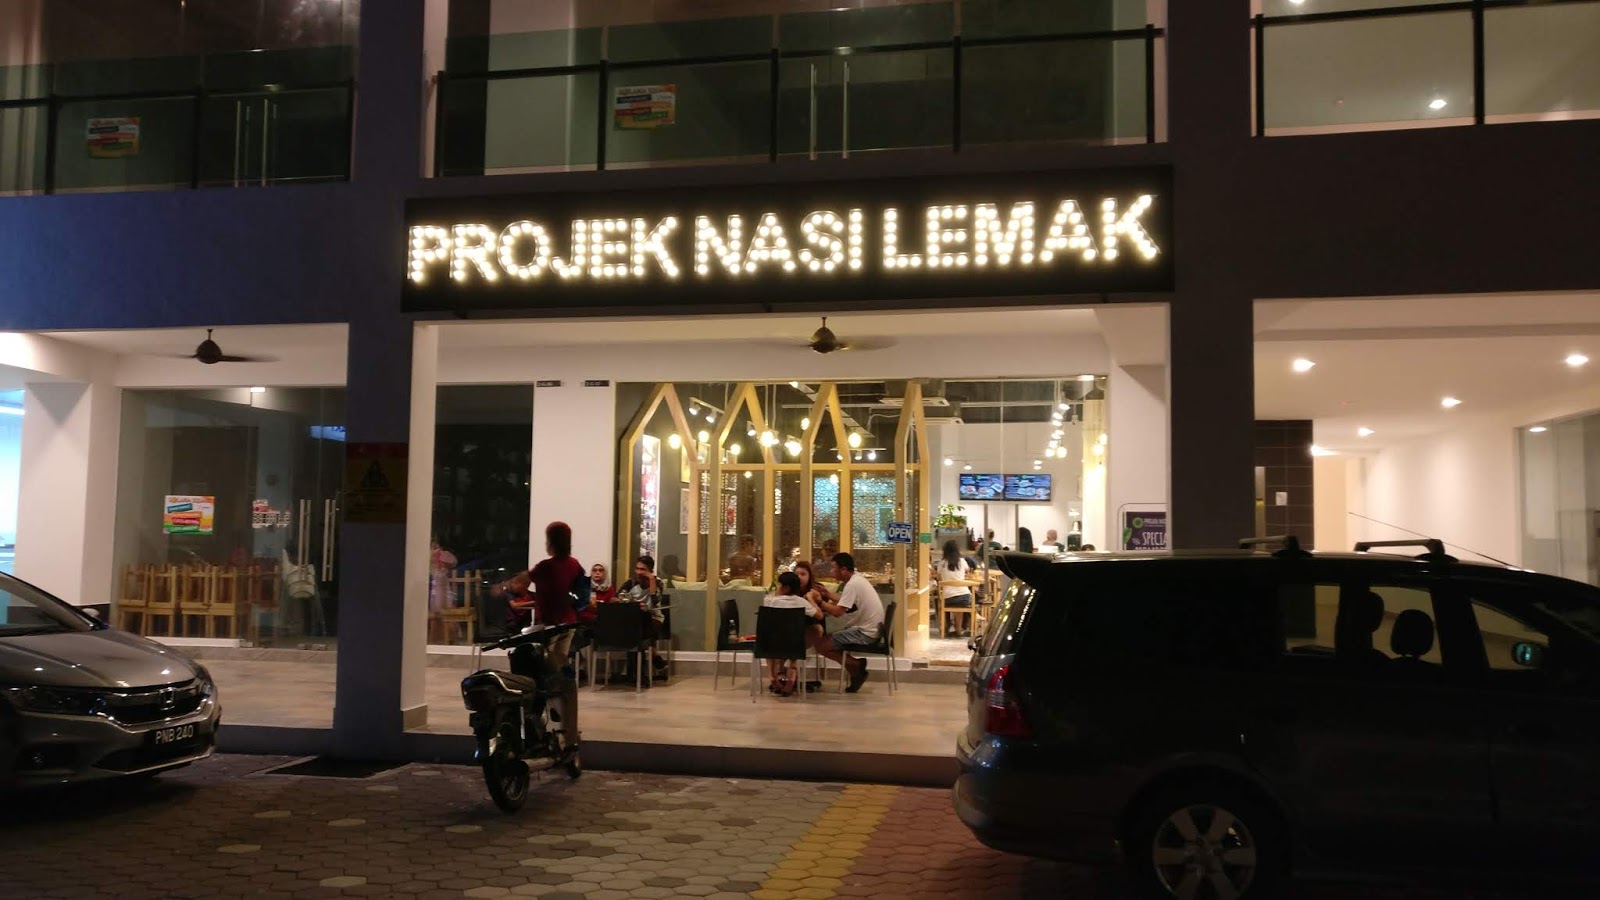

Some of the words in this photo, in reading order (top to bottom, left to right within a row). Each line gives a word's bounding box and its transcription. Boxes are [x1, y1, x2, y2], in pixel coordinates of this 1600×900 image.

[407, 216, 680, 283] PROJEK
[694, 208, 863, 275] NASI
[883, 194, 1161, 270] LEMAK
[888, 527, 912, 539] OPEN
[155, 728, 175, 745] PNB
[176, 725, 194, 740] 240
